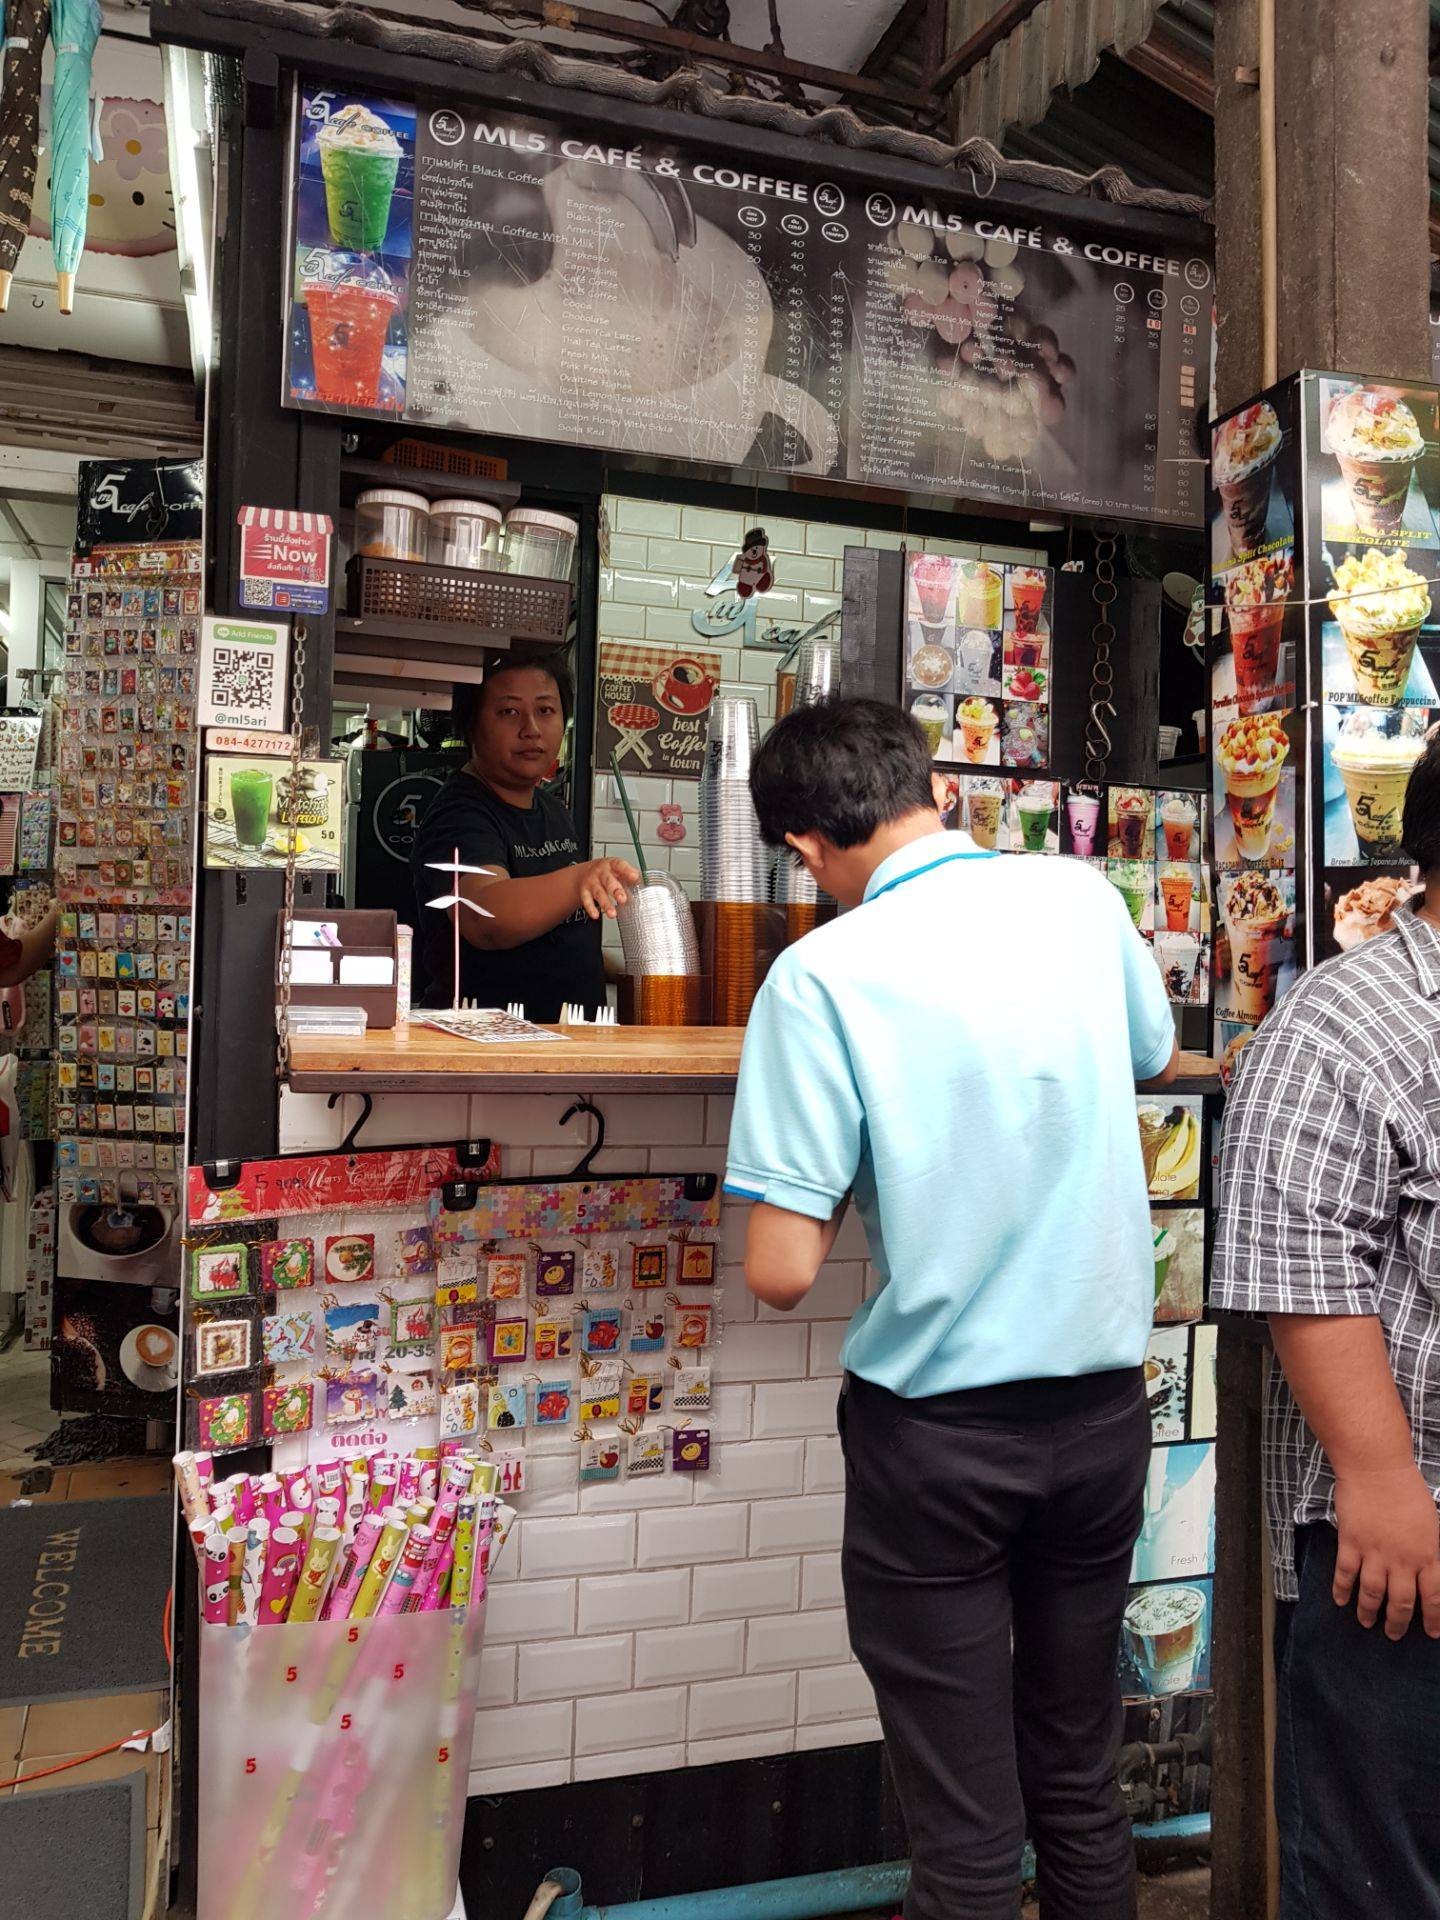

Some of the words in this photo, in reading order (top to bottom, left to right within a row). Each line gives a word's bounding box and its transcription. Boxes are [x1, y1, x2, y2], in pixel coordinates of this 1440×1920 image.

[473, 123, 546, 151] ML5
[560, 140, 643, 170] CAFÉ
[655, 158, 680, 177] &
[693, 165, 808, 201] COFFEE
[473, 164, 503, 178] Black
[508, 171, 545, 186] Coffee
[566, 211, 591, 223] Black
[595, 216, 625, 229] Coffee
[502, 225, 539, 239] Coffee
[543, 231, 568, 243] With
[572, 237, 594, 248] Milk
[748, 231, 762, 240] 30
[902, 206, 962, 232] ML5
[975, 220, 1042, 248] CAFÉ
[1053, 238, 1074, 255] &
[1084, 243, 1180, 276] COFFEE
[747, 243, 762, 253] 30
[791, 240, 805, 248] 40
[790, 251, 805, 260] 40
[449, 268, 471, 278] ML5
[790, 263, 804, 272] 40
[788, 287, 803, 296] 40
[788, 299, 803, 308] 40
[976, 299, 998, 310] Lemon
[1002, 303, 1015, 312] Tea
[561, 324, 591, 335] Green
[1016, 338, 1042, 350] Yogurt
[1009, 358, 1035, 369] Yogurt
[1391, 530, 1432, 540] SPLIT
[273, 544, 318, 564] Now
[79, 565, 85, 575] 5
[194, 562, 200, 570] 5
[231, 630, 245, 639] Add
[247, 631, 274, 641] Friends
[604, 684, 632, 693] COFFEE
[604, 691, 632, 701] HOUSE
[214, 712, 267, 727] @ml5ari
[672, 716, 700, 732] best
[215, 736, 291, 751] 084-4277172
[670, 756, 700, 770] town
[278, 797, 325, 811] Mtcha
[281, 812, 325, 824] Lmon
[321, 830, 335, 840] 50
[132, 893, 138, 903] 5
[1215, 1007, 1236, 1019] Coffee
[1154, 1172, 1177, 1182] olate
[577, 1205, 586, 1217] 5
[385, 1344, 436, 1359] 20-35
[330, 1428, 388, 1448] ติดต่อ
[1152, 1428, 1180, 1438] offee
[1171, 1553, 1198, 1566] Fresh
[18, 1527, 81, 1659] WELCOME
[348, 1627, 359, 1643] 5
[287, 1667, 298, 1682] 5
[394, 1664, 404, 1679] 5
[340, 1715, 352, 1730] 5
[438, 1748, 449, 1763] 5
[246, 1758, 256, 1774] 5
